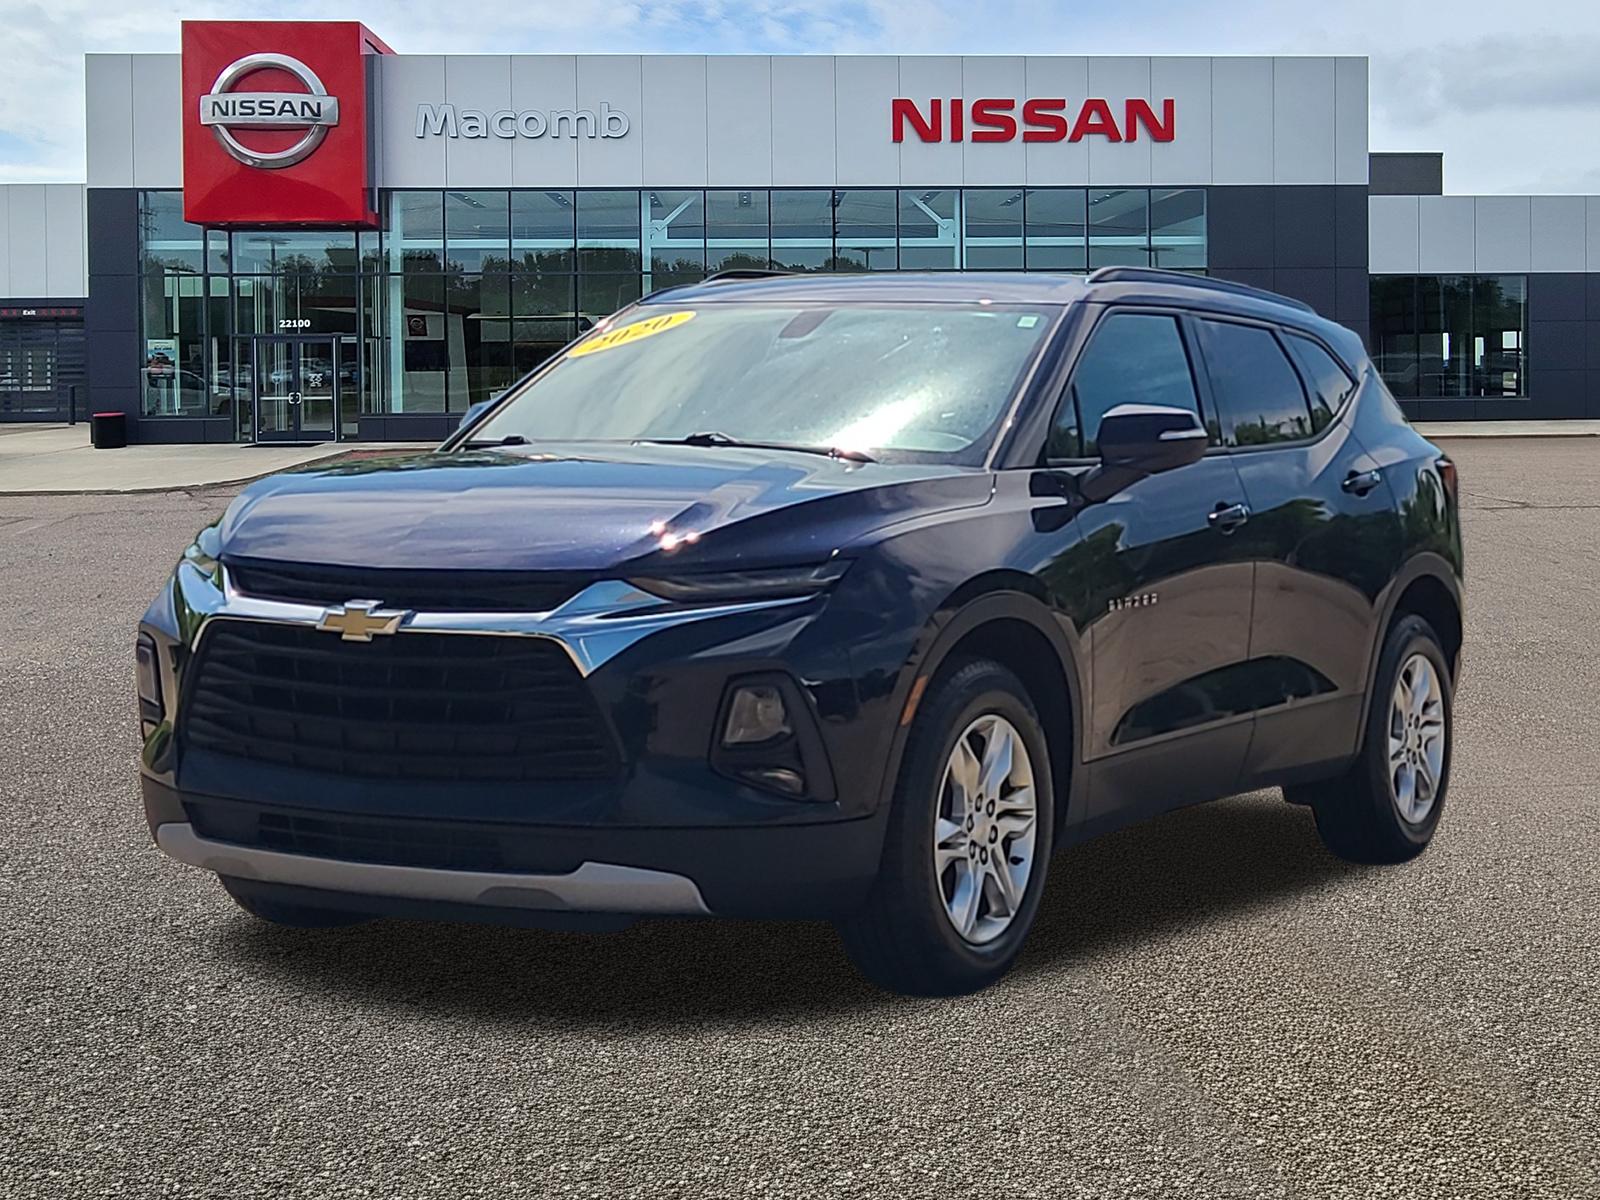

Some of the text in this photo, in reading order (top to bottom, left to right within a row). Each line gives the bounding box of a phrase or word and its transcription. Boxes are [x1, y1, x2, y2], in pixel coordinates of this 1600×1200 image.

[211, 100, 322, 118] NISSAN
[415, 101, 630, 139] Macomb
[891, 98, 1175, 143] NISSAN
[279, 319, 311, 328] 22100
